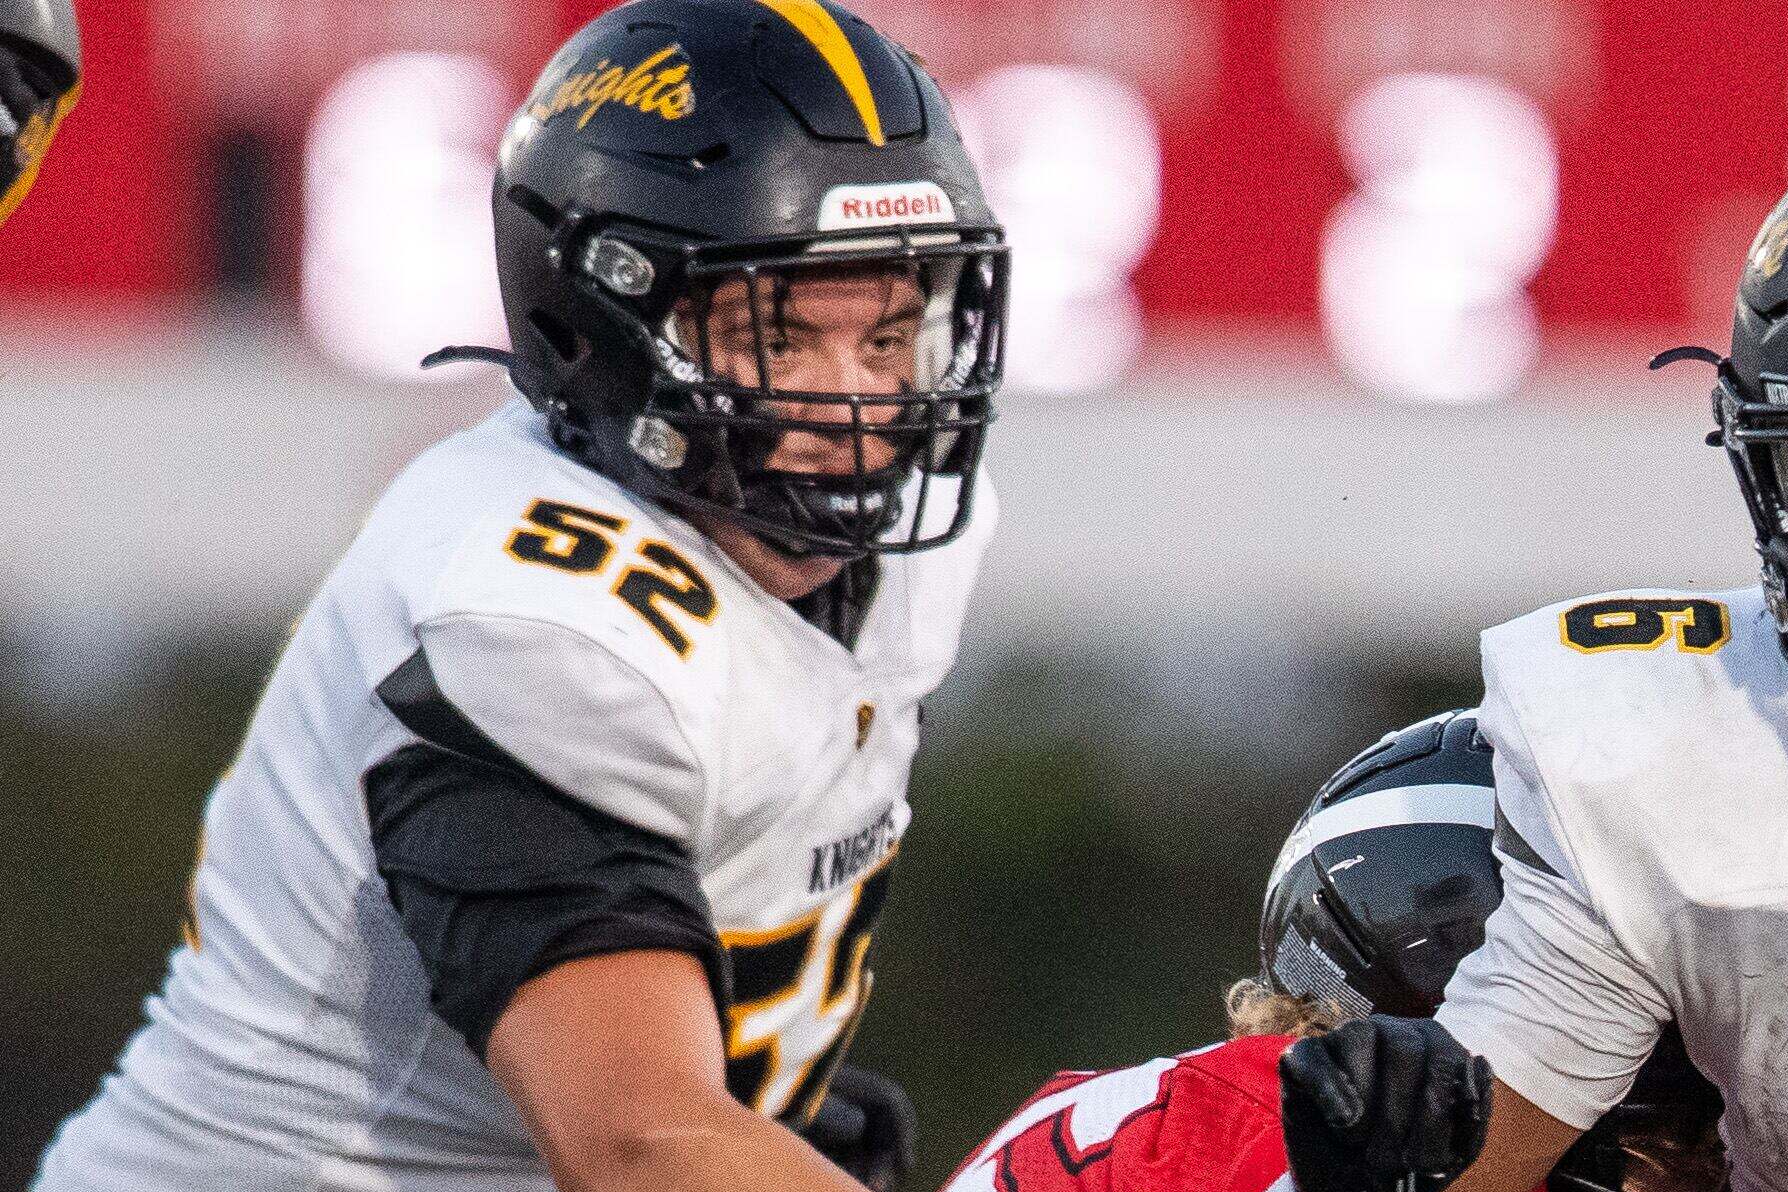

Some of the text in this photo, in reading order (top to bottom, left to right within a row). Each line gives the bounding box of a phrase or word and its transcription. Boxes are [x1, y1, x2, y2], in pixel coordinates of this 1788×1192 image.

[527, 42, 696, 132] nights
[842, 194, 942, 220] Riddell
[505, 498, 722, 662] 52
[1558, 598, 1732, 656] 6
